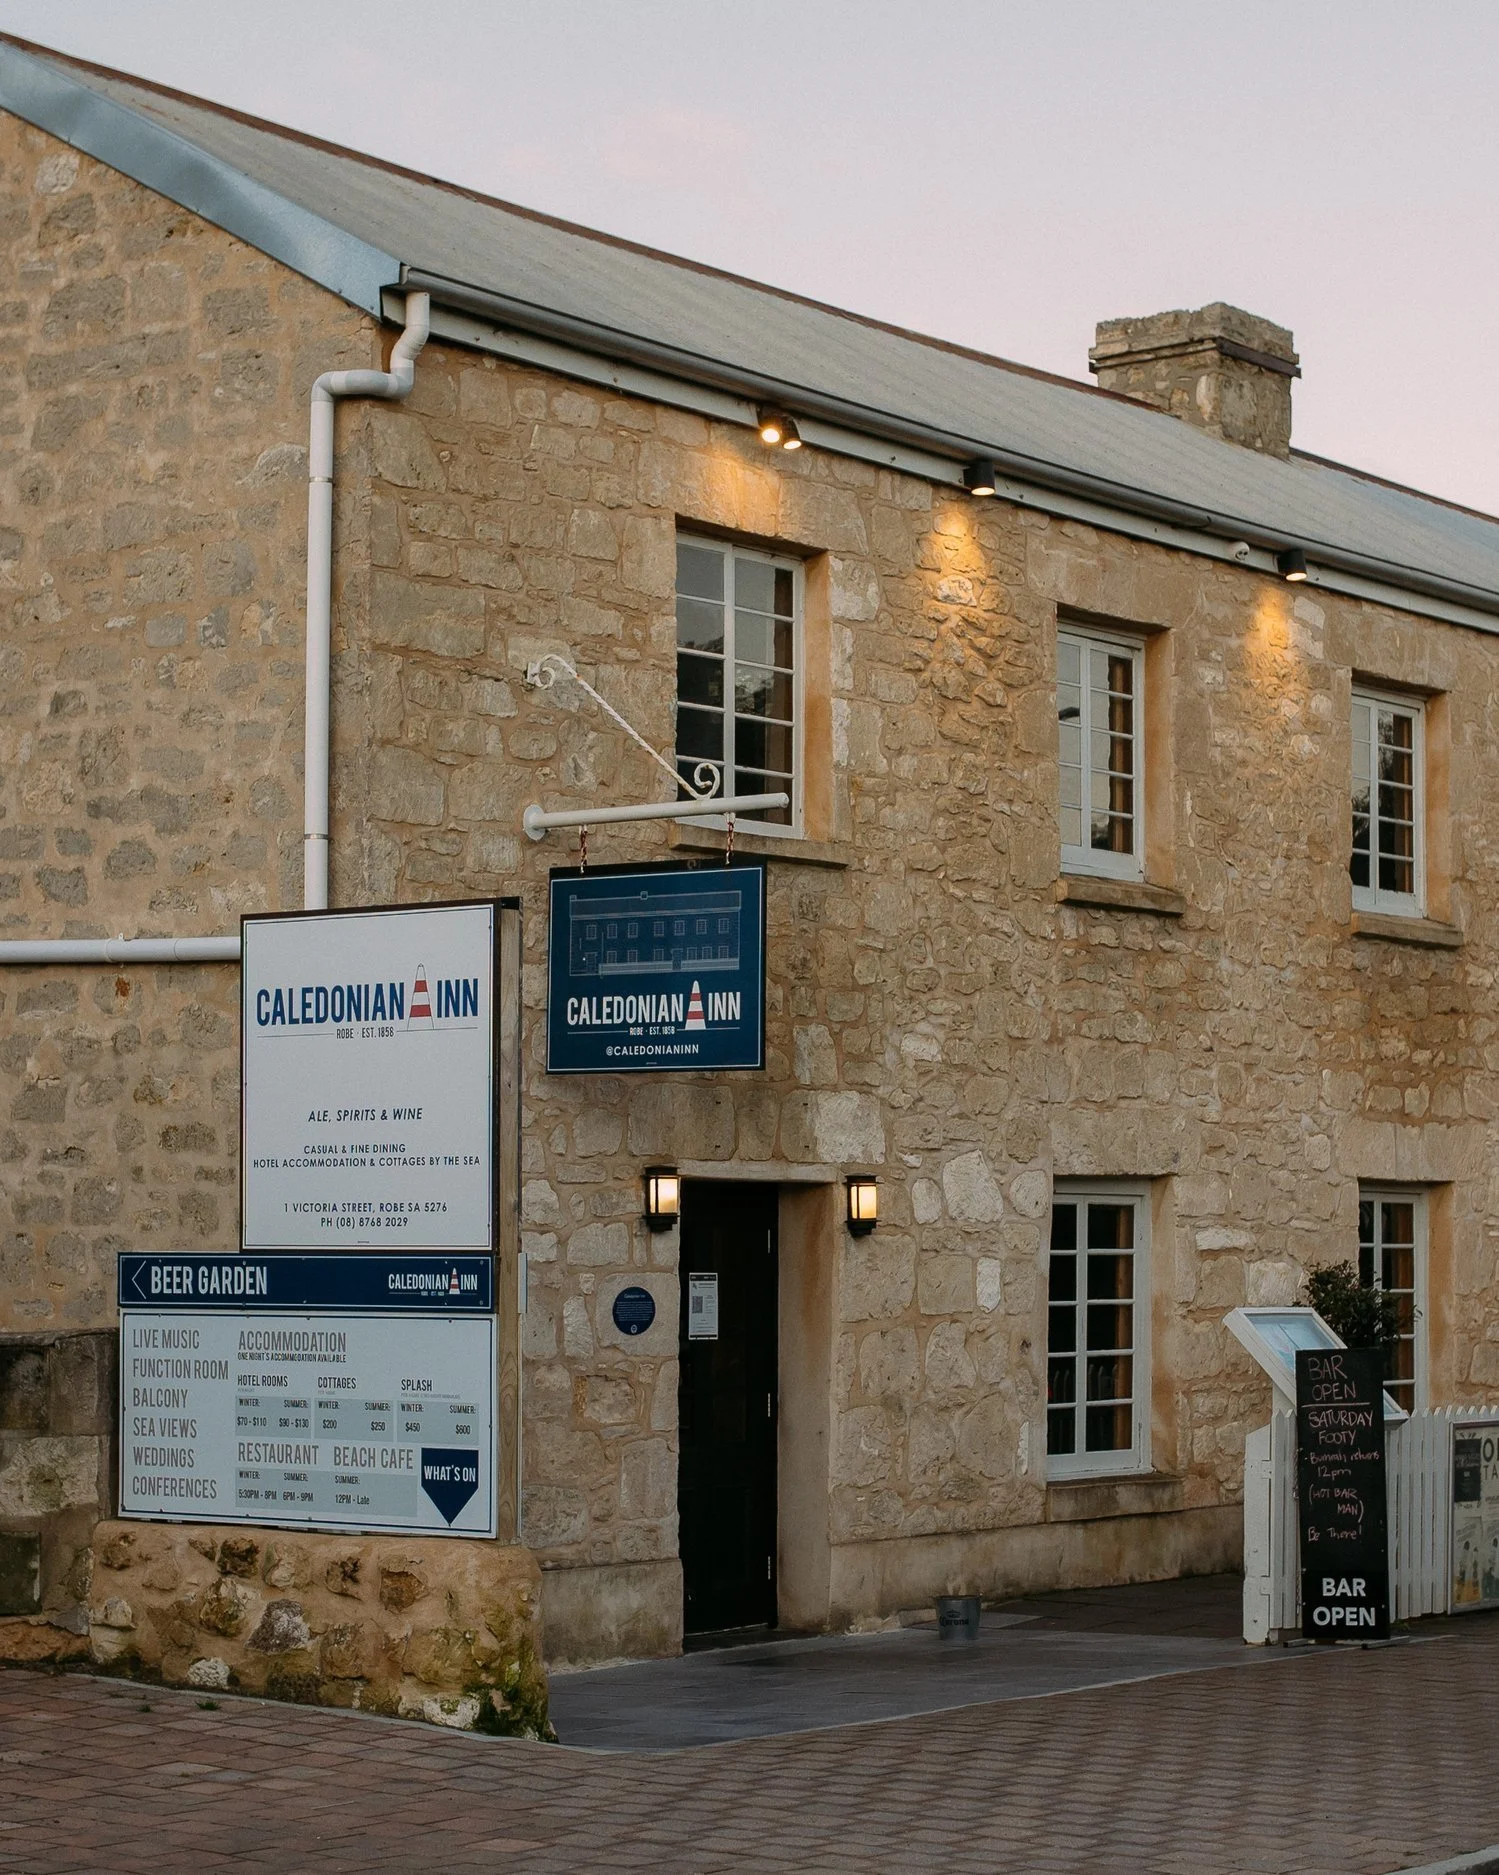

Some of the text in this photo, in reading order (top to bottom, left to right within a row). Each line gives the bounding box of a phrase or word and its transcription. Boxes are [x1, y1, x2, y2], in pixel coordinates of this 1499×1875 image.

[256, 978, 478, 1027] CALEDONIAN INN
[567, 992, 741, 1026] CALEDONIAN INN
[336, 1026, 394, 1039] ROBE EST. 1858
[629, 1027, 644, 1036] ROBE
[662, 1026, 675, 1035] 1858
[606, 1044, 699, 1056] @CALEDONIANINN
[308, 1107, 423, 1123] ALE, SPIRITS & WINE
[303, 1143, 406, 1154] CASUAL & FINE DINING
[253, 1156, 480, 1168] HOTEL ACCOMMODATION & COTTAGES BY THE SEA
[284, 1202, 447, 1214] 1 VICTORIA STREET, ROBE SA 5276
[320, 1217, 408, 1229] PH (08) 8768 2029
[151, 1266, 268, 1295] BEER GARDEN
[388, 1273, 478, 1290] CALEDONIAN INN
[132, 1328, 200, 1349] LIVE MUSIC
[238, 1331, 346, 1352] ACCOMMODATION
[237, 1352, 248, 1361] ONE
[132, 1358, 229, 1380] FUNCTION ROOM
[1308, 1354, 1348, 1380] BAR
[237, 1374, 288, 1387] HOTEL ROOMS
[317, 1376, 357, 1389] COTTAGES
[401, 1379, 432, 1392] SPLASH
[133, 1388, 188, 1409] BALCONY
[1311, 1381, 1356, 1401] OPEN
[237, 1416, 248, 1426] $70
[252, 1417, 267, 1427] $110
[322, 1419, 337, 1429] $200
[371, 1421, 386, 1431] $250
[1308, 1409, 1374, 1428] SATURDAY
[133, 1417, 198, 1439] SEA VIEWS
[405, 1422, 420, 1432] $450
[1318, 1430, 1357, 1446] FOOTY
[133, 1446, 195, 1469] WEDDINGS
[237, 1442, 319, 1465] RESTAURANT
[333, 1446, 414, 1470] BEACH CAFE
[424, 1464, 476, 1482] WHAT'S ON
[1317, 1465, 1352, 1480] 12pm
[132, 1476, 217, 1500] CONFERENCES
[238, 1490, 259, 1499] 5:30PM
[264, 1490, 277, 1500] 8PM
[1334, 1488, 1358, 1500] BAR
[335, 1494, 351, 1504] 12PM
[356, 1495, 370, 1505] Late
[1308, 1526, 1320, 1541] Be
[1322, 1577, 1366, 1597] BAR
[1313, 1606, 1376, 1627] OPEN
